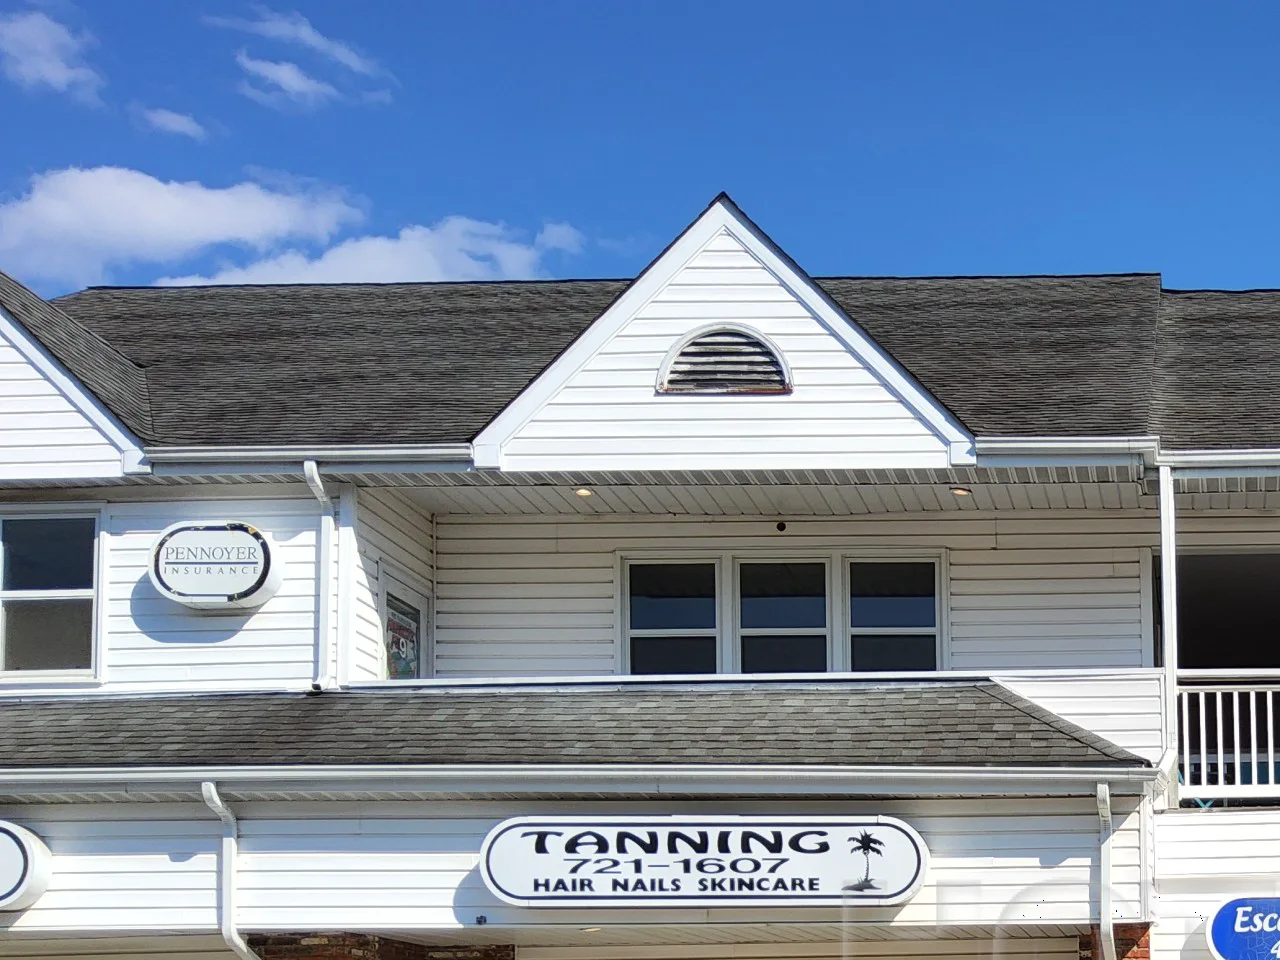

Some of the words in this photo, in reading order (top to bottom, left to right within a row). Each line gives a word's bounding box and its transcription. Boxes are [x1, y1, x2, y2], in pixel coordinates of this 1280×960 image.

[165, 546, 258, 560] PENNOYER
[164, 566, 259, 575] INSURANCE
[520, 830, 830, 856] TANNING
[562, 857, 790, 875] 721-1607
[532, 877, 595, 892] HAIR
[611, 877, 682, 892] NAILS
[698, 877, 820, 892] SKINCARE
